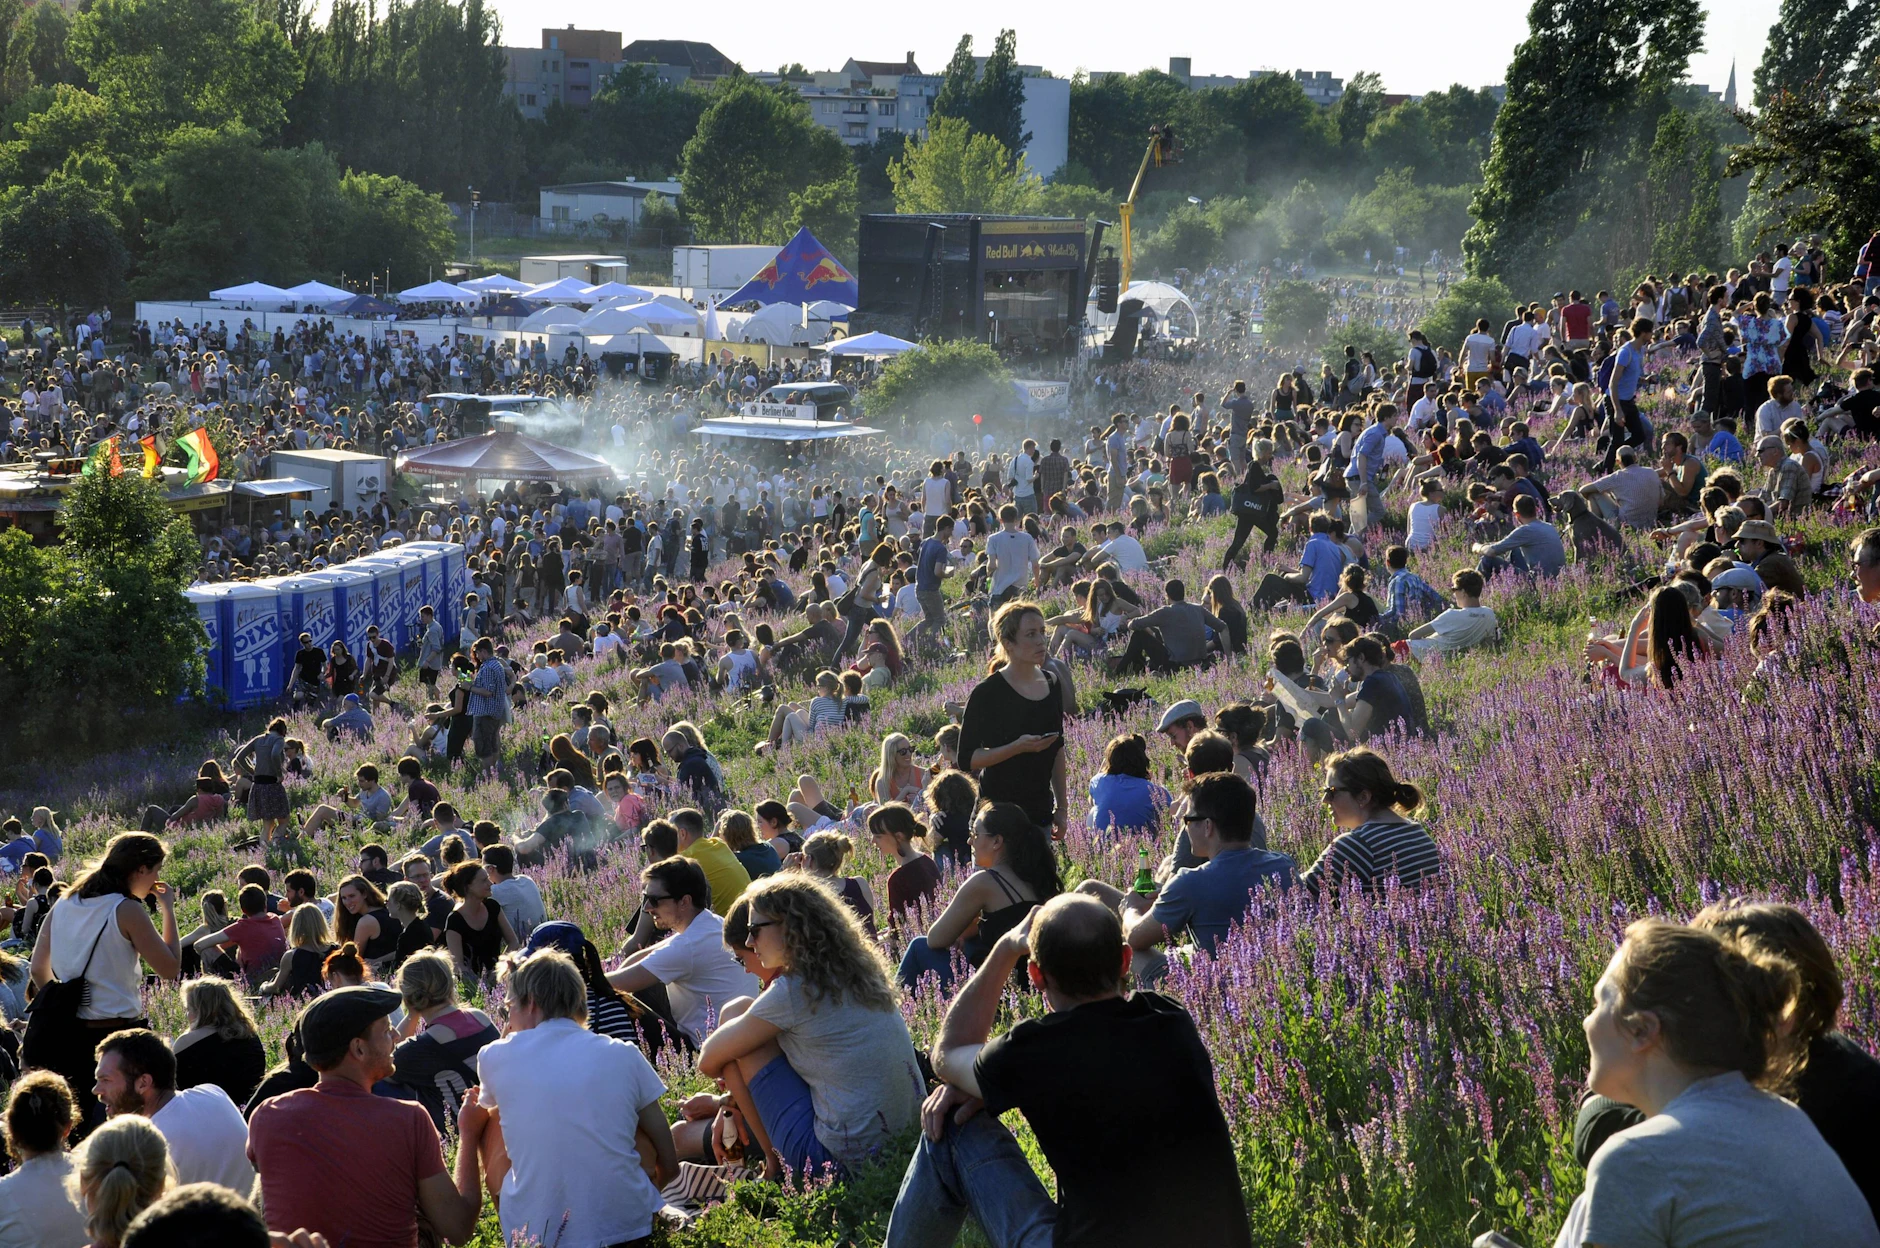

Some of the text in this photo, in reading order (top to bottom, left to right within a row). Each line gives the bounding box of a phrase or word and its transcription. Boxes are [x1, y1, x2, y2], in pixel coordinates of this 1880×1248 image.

[986, 246, 1001, 259] Red
[1002, 244, 1018, 258] Bull
[761, 405, 797, 417] Berliner Kindl
